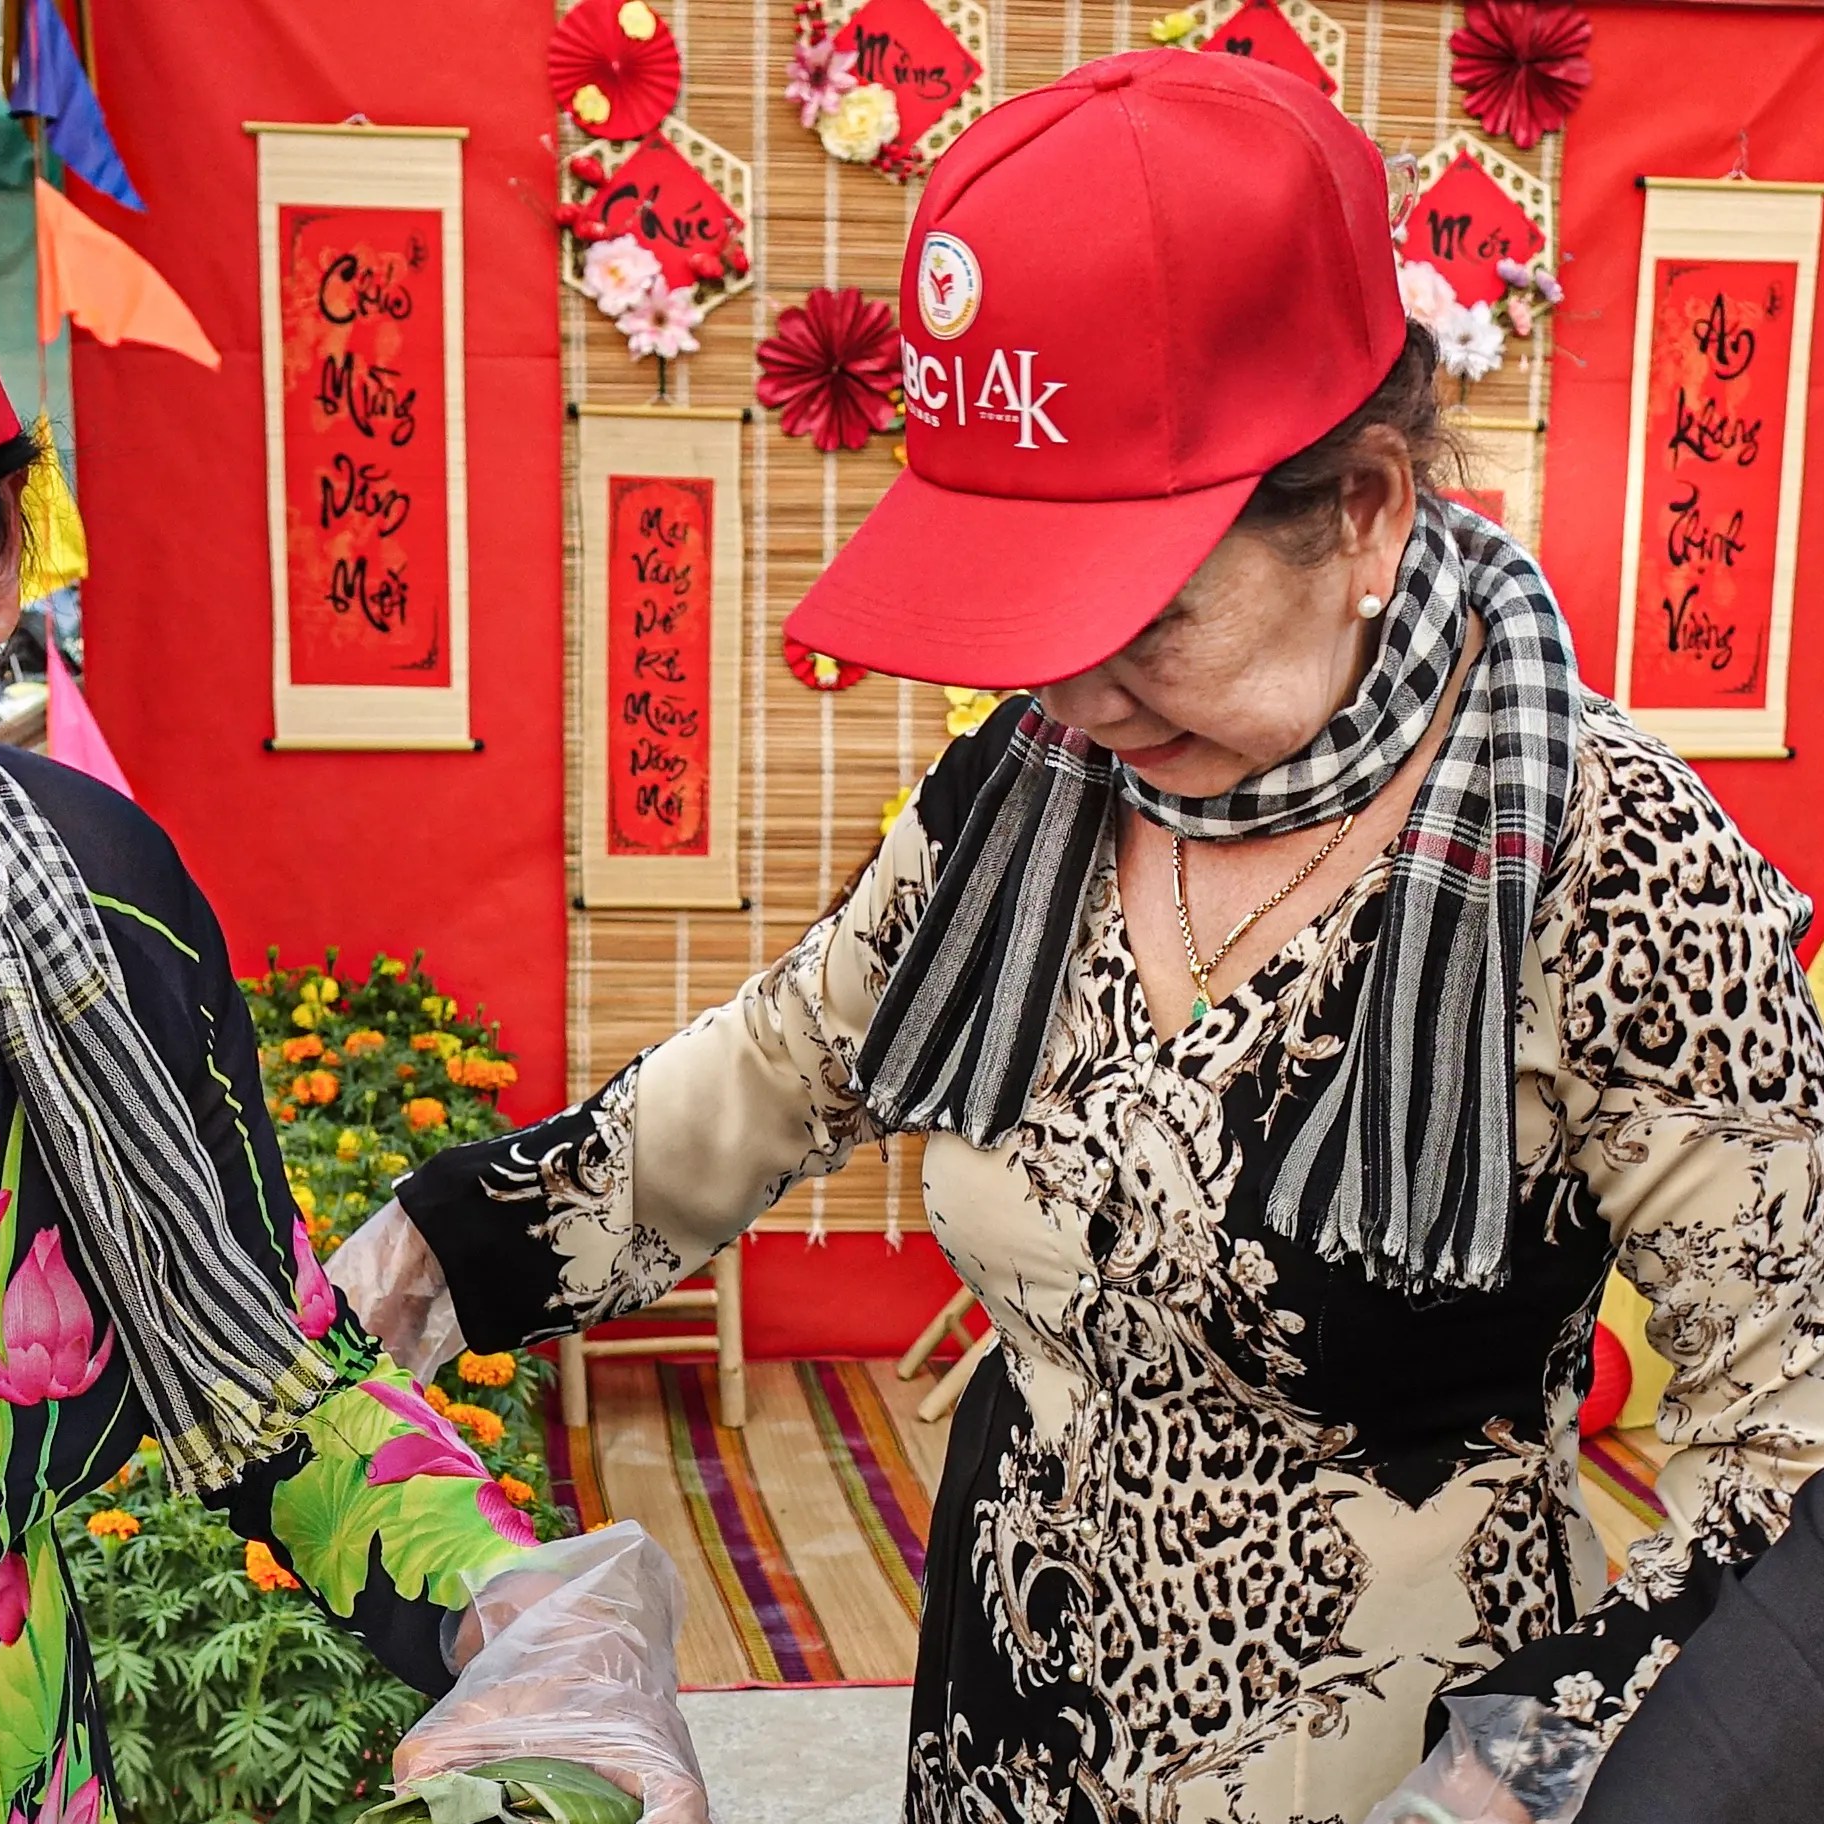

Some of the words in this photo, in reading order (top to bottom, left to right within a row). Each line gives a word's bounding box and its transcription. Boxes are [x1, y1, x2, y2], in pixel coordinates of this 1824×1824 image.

[900, 333, 948, 410] BC
[1692, 292, 1756, 381] An
[1667, 386, 1762, 471] Khang
[320, 452, 411, 538] Năm
[1666, 479, 1746, 575] Thịnh
[1663, 584, 1737, 672] Vượng
